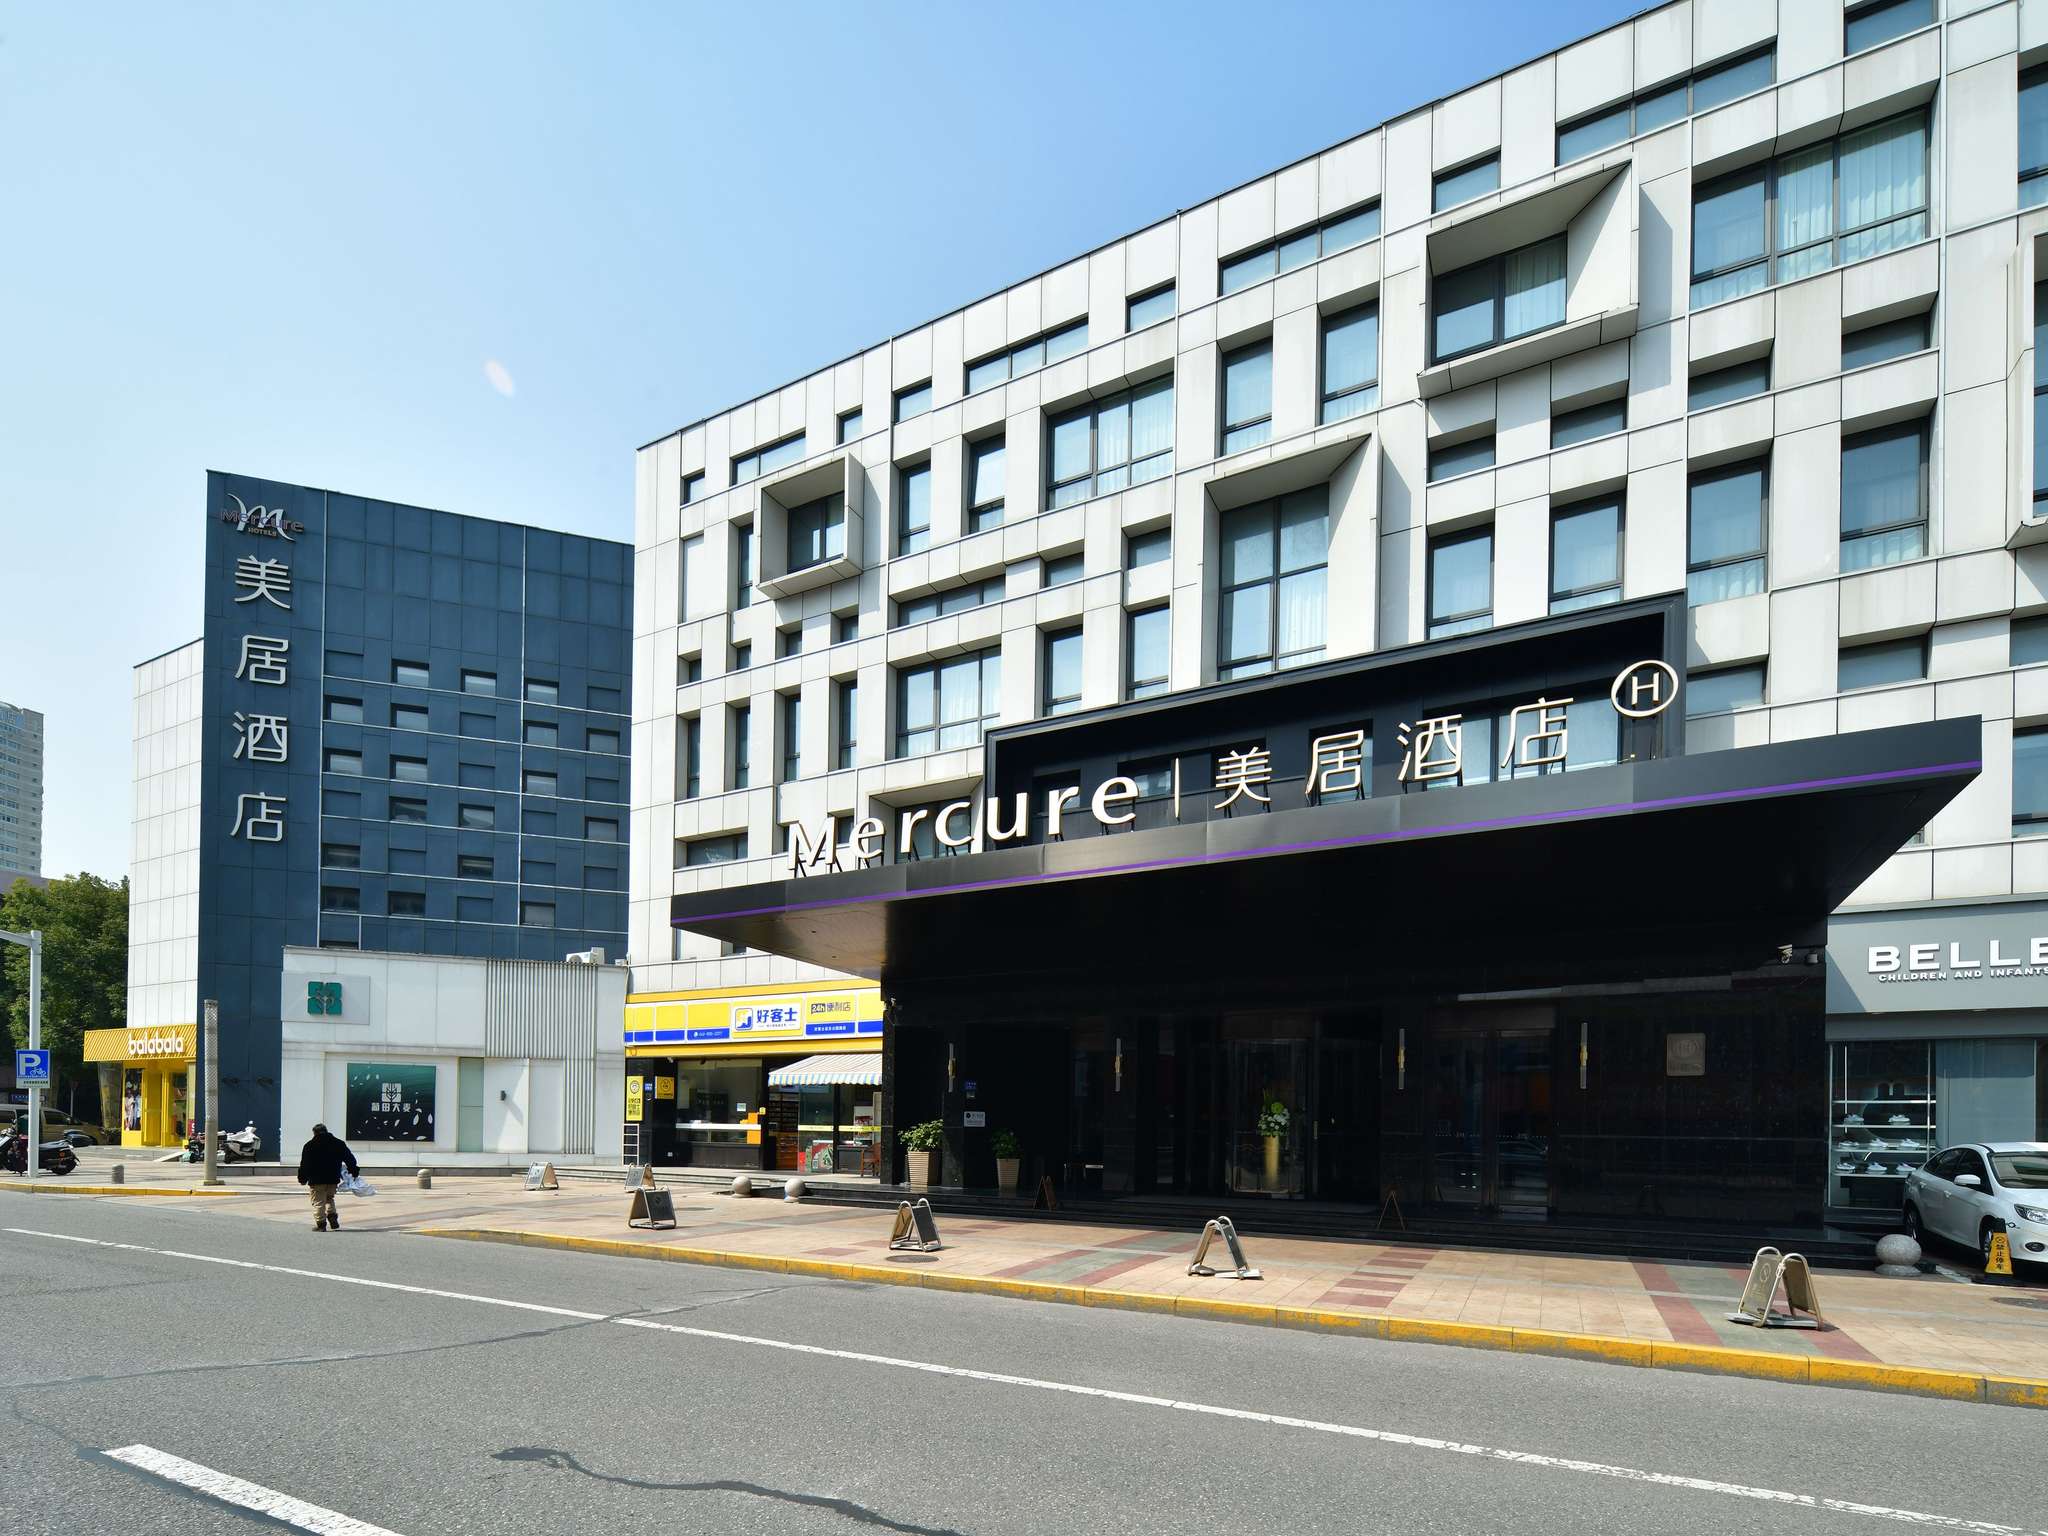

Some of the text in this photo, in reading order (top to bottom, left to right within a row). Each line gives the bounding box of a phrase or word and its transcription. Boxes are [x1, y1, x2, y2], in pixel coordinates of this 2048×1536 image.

[220, 509, 305, 532] Mercure
[248, 527, 277, 537] HOTELS
[230, 555, 292, 842] 美居酒店
[787, 696, 1574, 870] Mercure 美居酒店
[1878, 971, 1948, 982] CHILDREN
[1953, 970, 1983, 979] AND
[756, 1007, 798, 1023] 好客士
[128, 1031, 185, 1055] balabala
[19, 1053, 41, 1075] P
